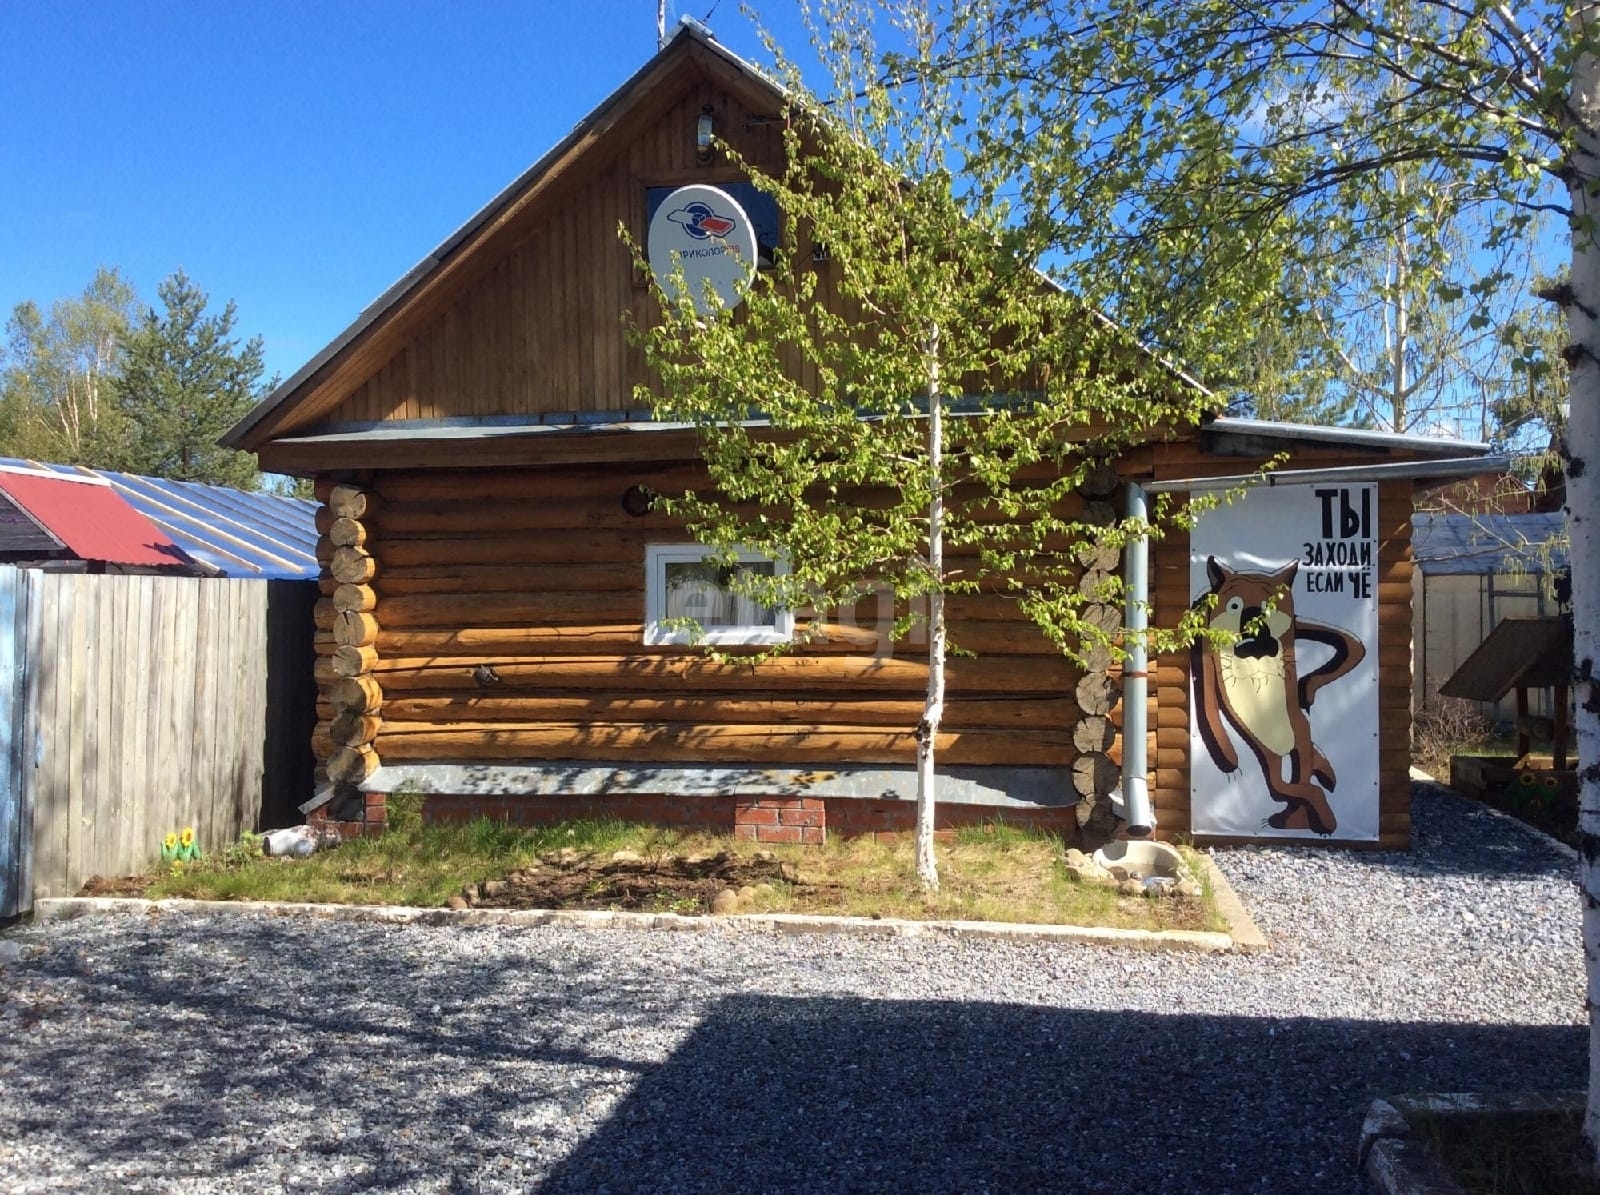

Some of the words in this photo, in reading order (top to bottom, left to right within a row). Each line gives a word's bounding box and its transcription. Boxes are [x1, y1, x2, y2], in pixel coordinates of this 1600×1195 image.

[1315, 488, 1371, 539] ТЫ
[1307, 572, 1344, 593] ЕСЛИ
[1348, 566, 1371, 599] ЧЁ
